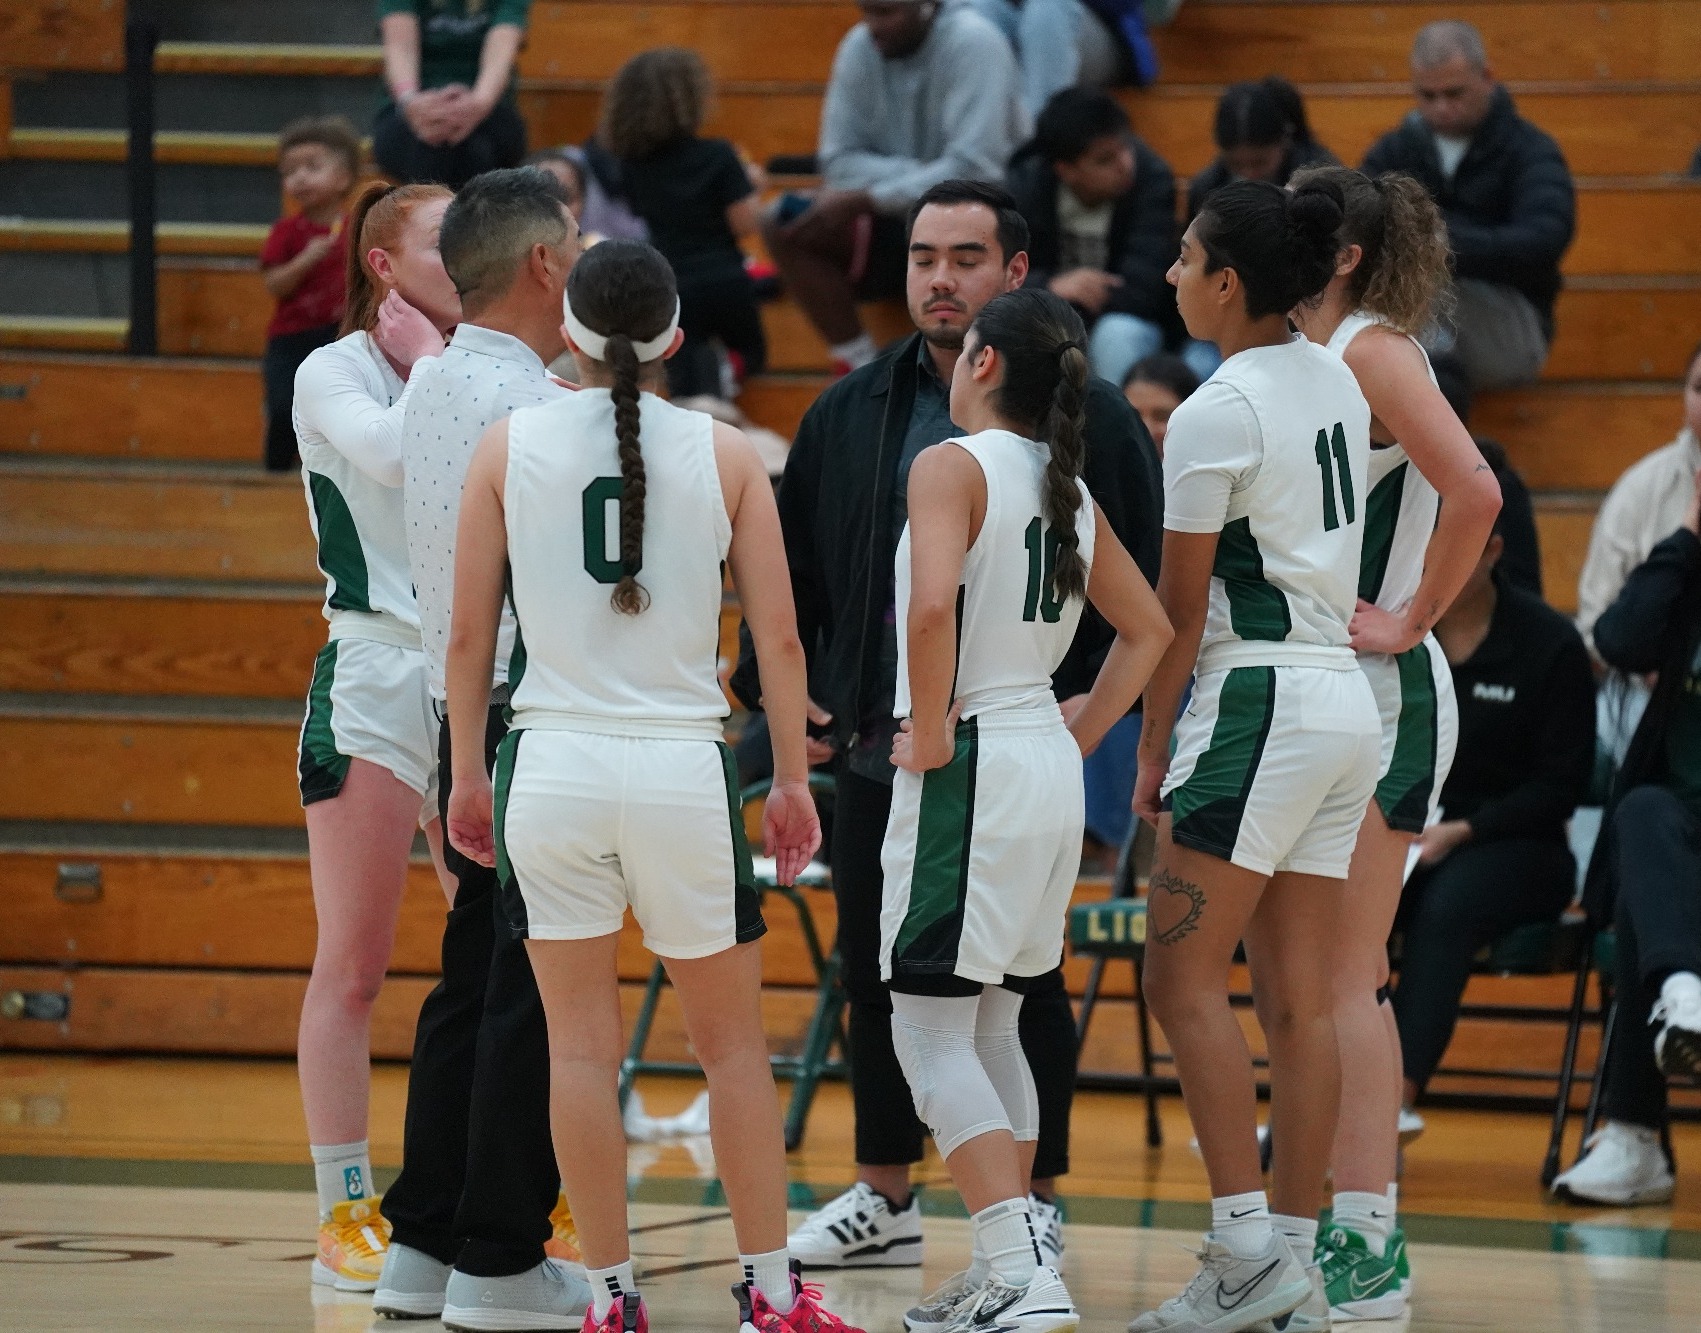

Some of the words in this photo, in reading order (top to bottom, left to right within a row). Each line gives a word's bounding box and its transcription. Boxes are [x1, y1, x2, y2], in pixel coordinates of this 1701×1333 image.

[582, 476, 643, 584] 0
[1314, 421, 1355, 532] 11
[1022, 515, 1071, 623] 10
